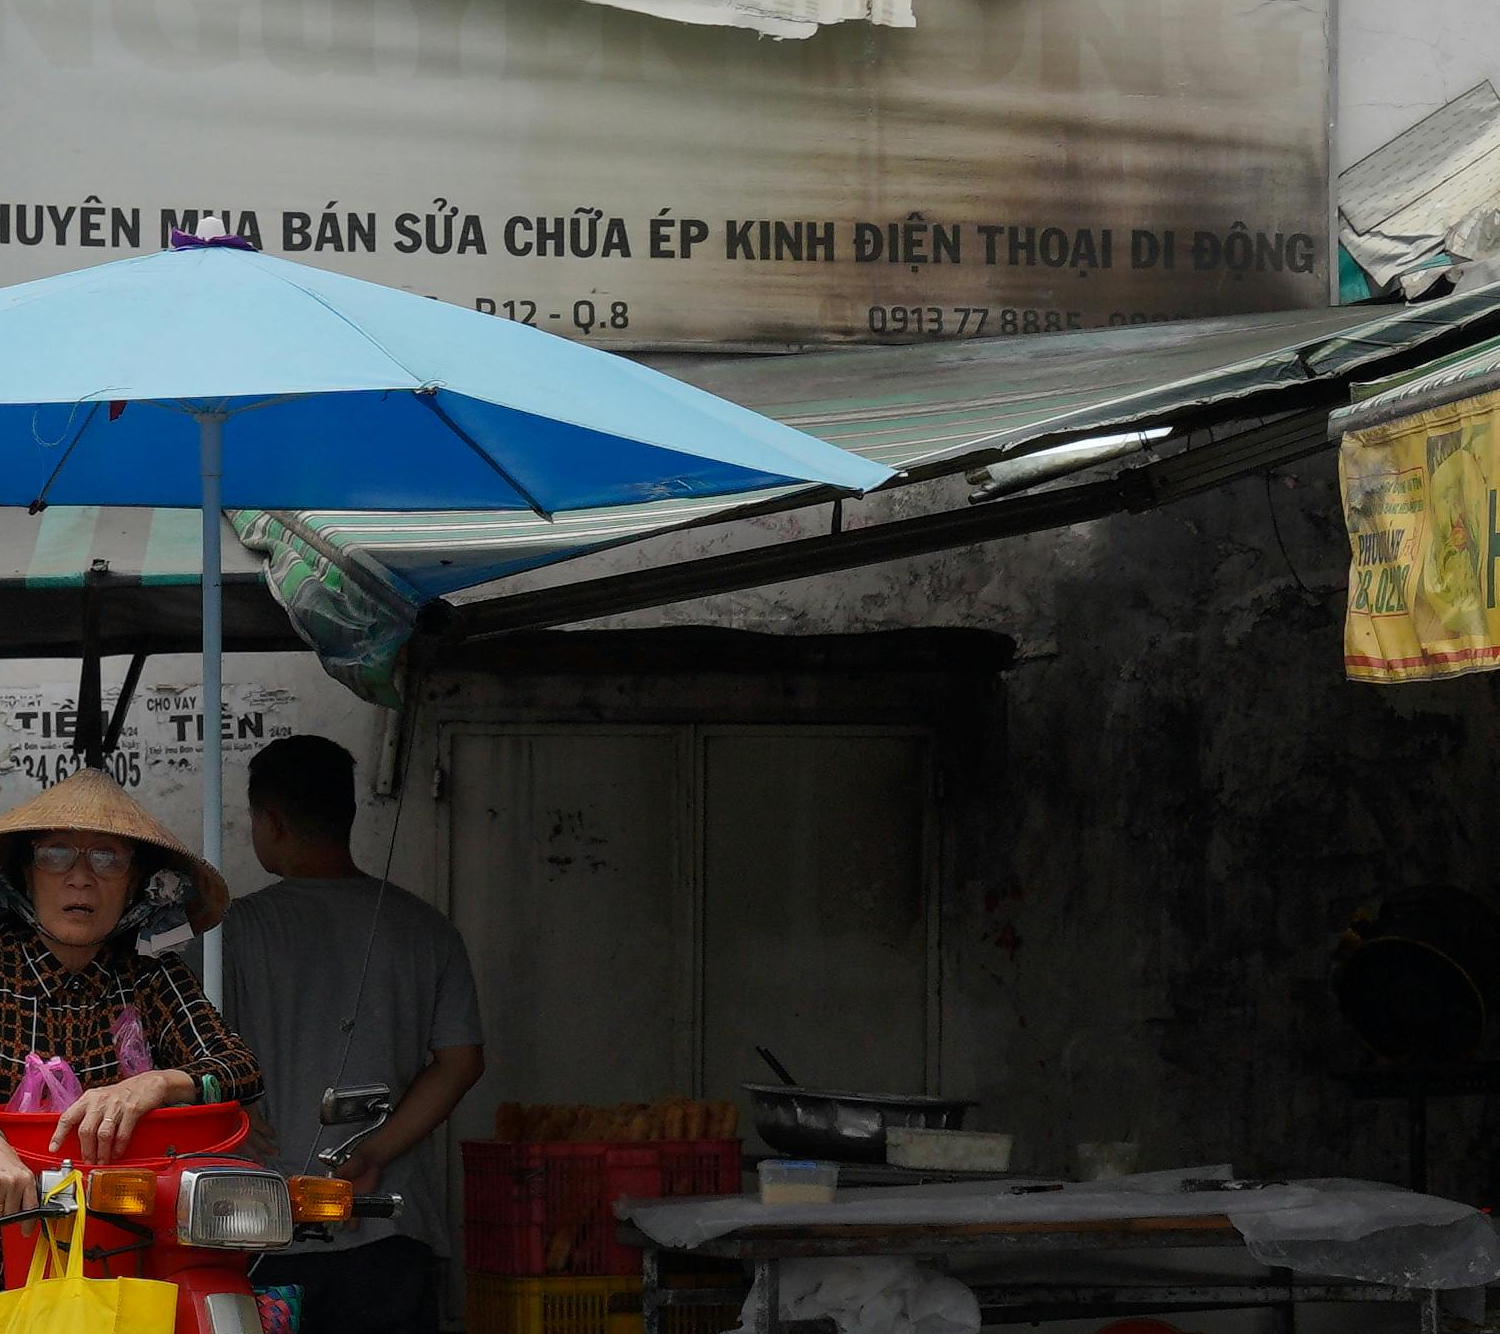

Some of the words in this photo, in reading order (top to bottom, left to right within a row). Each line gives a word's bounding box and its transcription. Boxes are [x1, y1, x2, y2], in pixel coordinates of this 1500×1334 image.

[282, 201, 377, 253] BÁN
[394, 198, 488, 256] SỬA
[504, 206, 632, 259] CHỮA
[649, 208, 708, 259] ÉP
[726, 220, 834, 262] KINH
[853, 212, 961, 274] ĐIỆN
[977, 225, 1113, 276] THOẠI
[1131, 230, 1174, 267] DI
[1191, 221, 1314, 275] ĐỘNG
[573, 300, 629, 335] Q.8
[868, 306, 944, 335] 0913
[954, 308, 990, 334] 77
[146, 697, 171, 711] CHO
[173, 696, 197, 710] VAY
